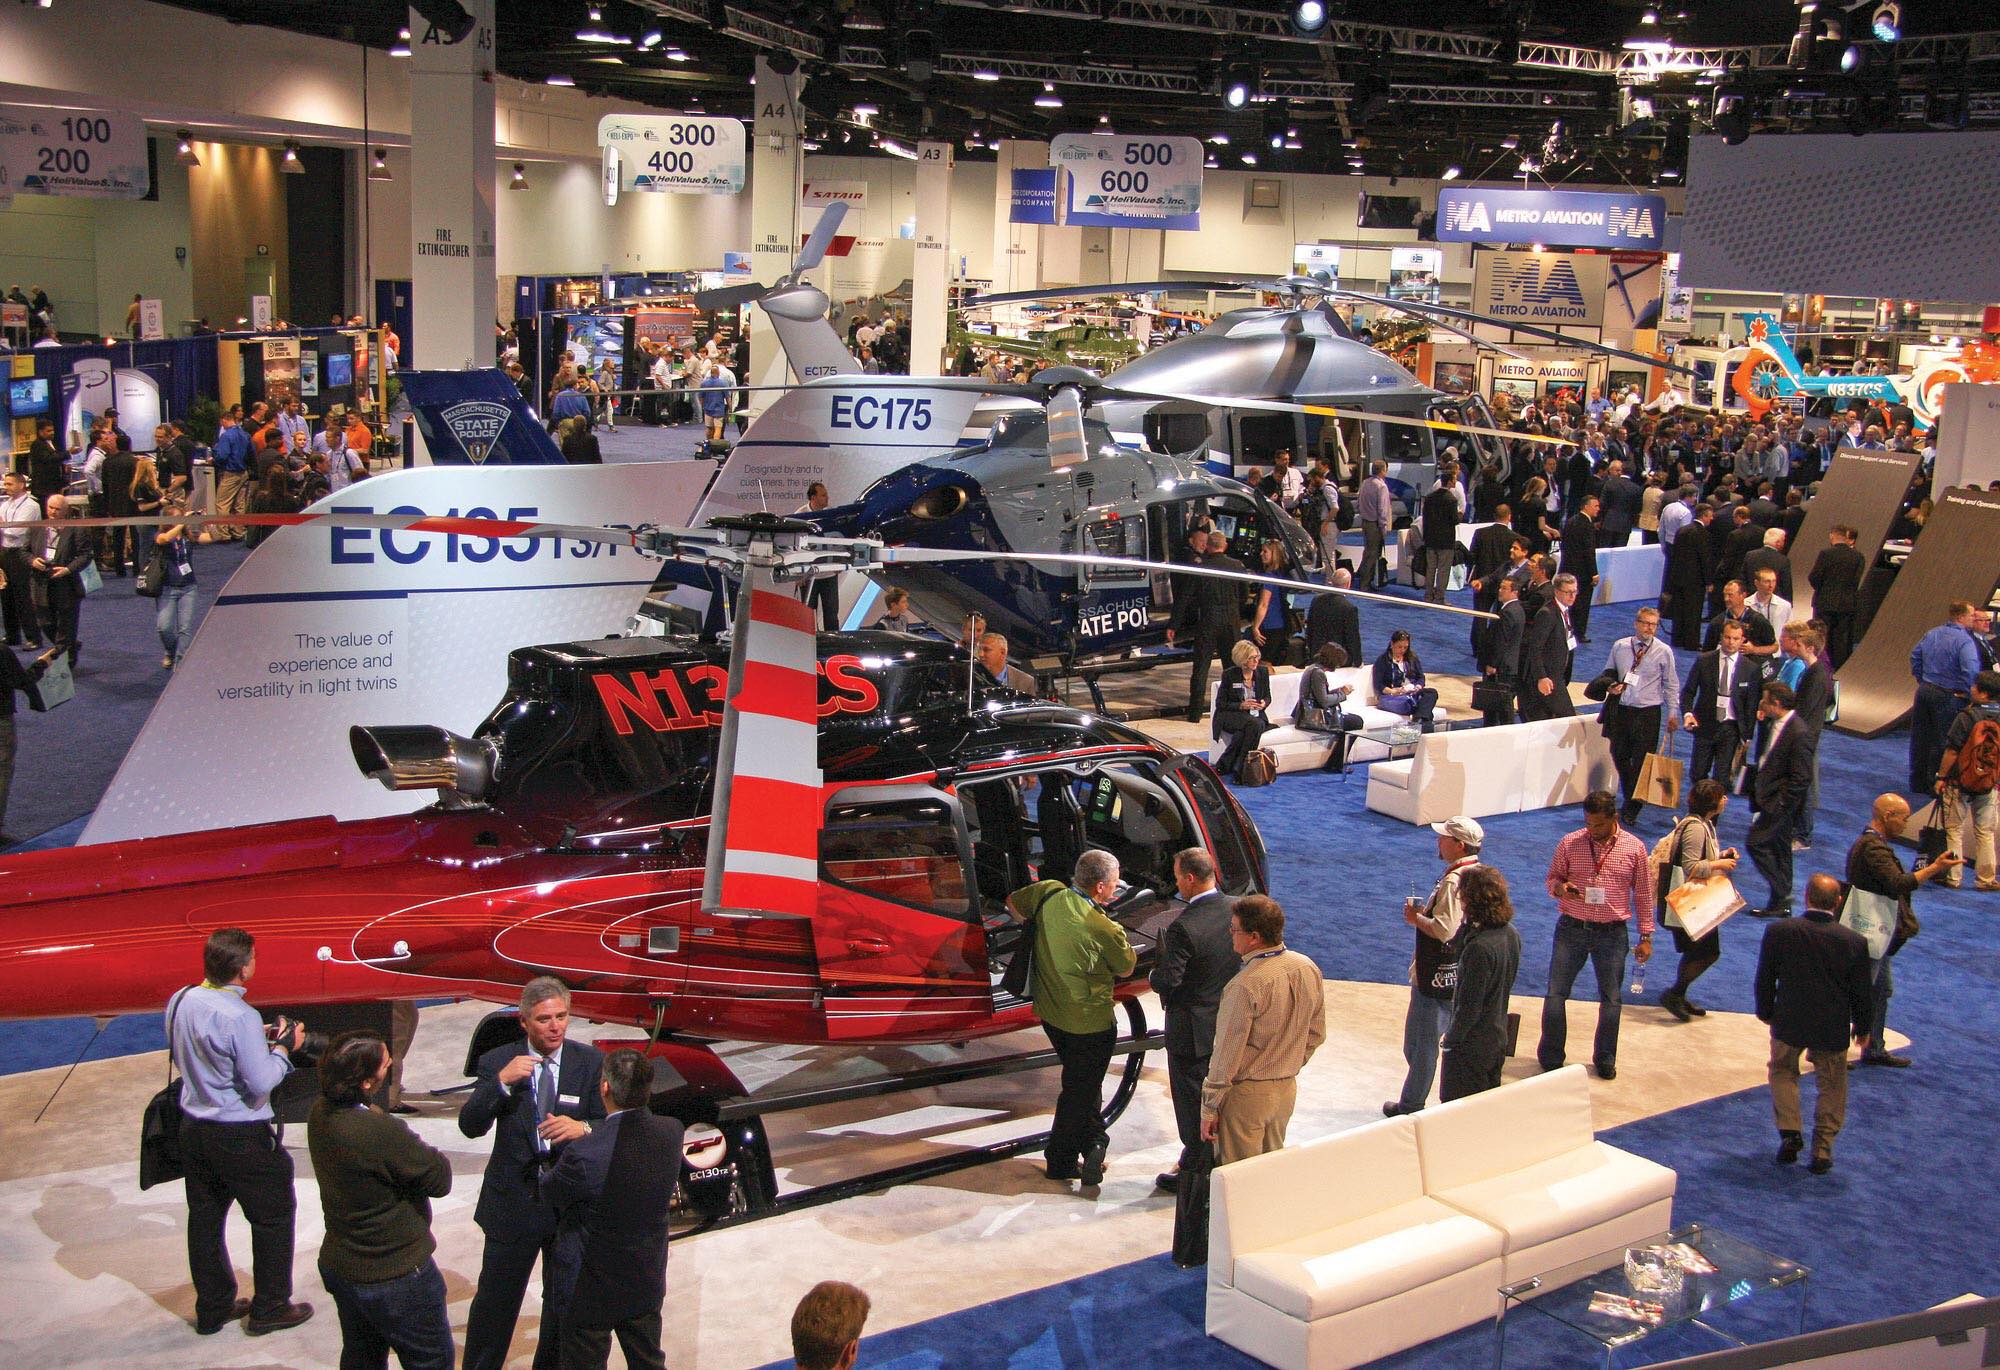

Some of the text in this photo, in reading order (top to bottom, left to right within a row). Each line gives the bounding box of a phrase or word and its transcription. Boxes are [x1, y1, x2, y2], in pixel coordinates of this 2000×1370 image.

[762, 103, 785, 118] A4
[62, 117, 111, 143] 100
[669, 123, 716, 147] 300
[38, 147, 90, 174] 200
[647, 150, 694, 173] 400
[923, 149, 941, 160] A3
[1124, 143, 1172, 165] 500
[712, 177, 731, 186] Inc.
[1100, 170, 1149, 193] 600
[812, 191, 864, 200] SATAIR
[1167, 197, 1186, 205] Inc.
[1445, 201, 1655, 239] MA METRO AVIATION MA
[436, 228, 452, 242] FIRE
[767, 234, 778, 244] FIRE
[418, 242, 470, 258] EXTINGUISHER
[755, 243, 789, 254] EXTINGUISHER
[1490, 257, 1585, 305] MA
[1489, 304, 1586, 318] METRO AVIATION
[805, 366, 838, 376] EC175
[1499, 365, 1584, 377] METRO AVIATION
[1827, 383, 1883, 397] N837CS
[444, 403, 508, 420] MASSACHUSETTS
[830, 395, 932, 431] EC175
[454, 418, 499, 431] STATE
[459, 429, 496, 439] POLICE
[744, 464, 824, 475] Designed by and for
[331, 505, 541, 565] EC135
[1078, 613, 1114, 638] ATE
[295, 630, 394, 649] The value of
[268, 652, 393, 676] experience and
[217, 674, 398, 701] versatility in light twins
[592, 654, 879, 735] N13S
